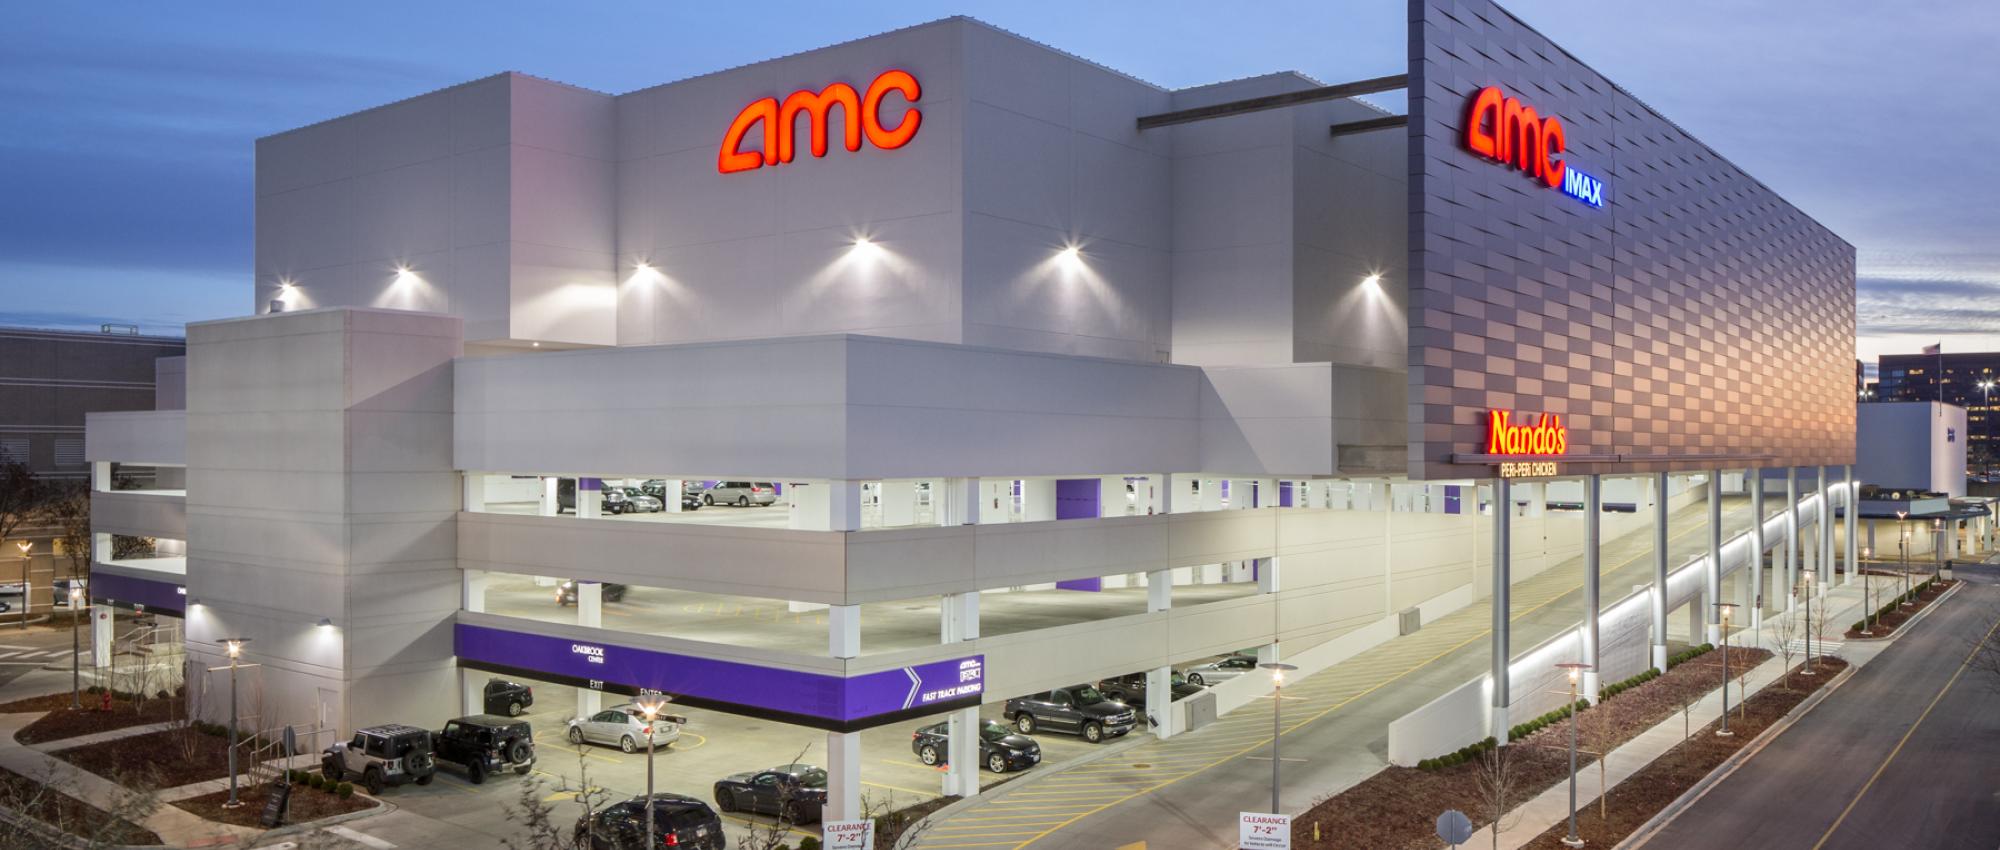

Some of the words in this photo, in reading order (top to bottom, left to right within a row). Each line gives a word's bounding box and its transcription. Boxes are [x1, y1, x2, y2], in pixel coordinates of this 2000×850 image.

[1565, 166, 1603, 207] IMAX
[1488, 408, 1567, 455] Nando's
[1501, 462, 1531, 478] PERI-PERI
[1532, 462, 1557, 476] CHICKEN
[572, 644, 604, 656] OAKBROOK
[589, 679, 604, 690] EXIT
[922, 691, 937, 702] FAST
[938, 687, 956, 699] TRACK
[957, 682, 981, 695] PARKING
[1243, 815, 1288, 825] CLEARANCE
[827, 822, 872, 832] CLEARANCE
[1253, 825, 1277, 835] 7'-2"
[837, 832, 861, 842] 7'-2"
